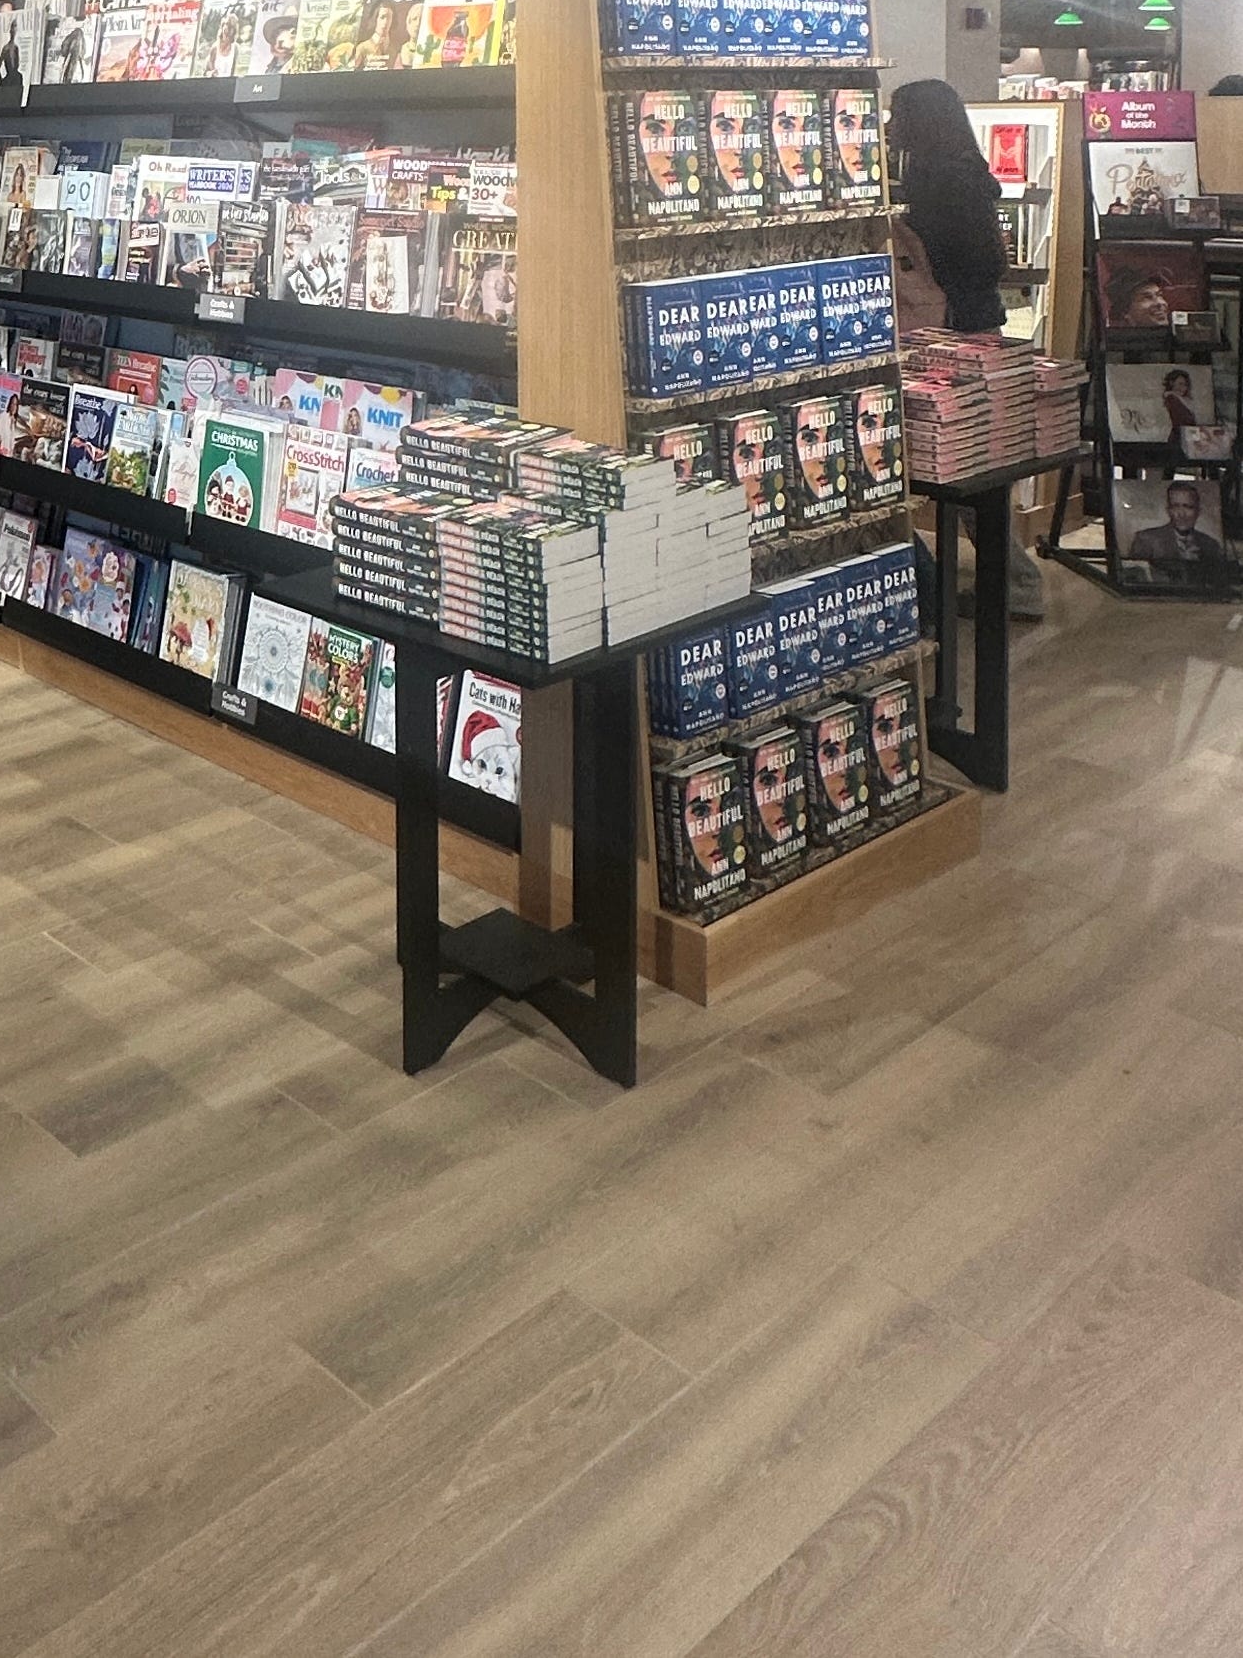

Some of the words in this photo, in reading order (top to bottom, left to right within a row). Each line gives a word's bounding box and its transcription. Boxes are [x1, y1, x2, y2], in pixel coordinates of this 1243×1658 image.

[654, 105, 685, 120] HELLO
[724, 103, 752, 118] HELLO
[785, 102, 812, 117] HELLO
[846, 101, 870, 115] HELLO
[1121, 102, 1155, 112] Album
[1121, 119, 1156, 130] Month
[643, 134, 698, 153] BEAUTIFUL
[714, 133, 763, 150] BEAUTIFUL
[776, 131, 822, 147] BEAUTIFUL
[836, 129, 879, 144] BEAUTIFUL
[189, 168, 236, 182] WRITER'S
[392, 159, 430, 170] WOOD
[431, 186, 456, 200] Tips
[471, 188, 498, 200] 30+
[172, 209, 207, 224] ORION
[780, 286, 816, 304] DEAR
[822, 282, 859, 300] DEAR
[658, 306, 700, 326] DEAR
[706, 298, 749, 320] DEAR
[780, 308, 817, 325] EDWARD
[823, 302, 860, 318] EDWARD
[659, 329, 701, 346] EDWARD
[707, 322, 749, 339] EDWARD
[75, 394, 101, 410] Breathe
[868, 397, 893, 415] HELLO
[367, 407, 404, 428] KNIT
[809, 411, 836, 430] HELLO
[211, 430, 259, 451] CHRISTMAS
[745, 425, 773, 445] HELLO
[859, 425, 902, 446] BEAUTIFUL
[405, 435, 429, 447] HELLO
[431, 440, 473, 459] BEAUTIFUL
[674, 441, 702, 461] HELLO
[799, 439, 845, 462] BEAUTIFUL
[356, 463, 396, 482] Crochet
[401, 454, 426, 467] HELLO
[427, 459, 469, 478] BEAUTIFUL
[737, 455, 784, 479] BEAUTIFUL
[405, 472, 429, 485] HELLO
[430, 478, 472, 496] BEAUTIFUL
[335, 506, 358, 519] HELLO
[359, 513, 400, 533] BEAUTIFUL
[338, 525, 360, 539] HELLO
[362, 532, 404, 552] BEAUTIFUL
[338, 544, 361, 559] HELLO
[363, 551, 405, 572] BEAUTIFUL
[339, 562, 363, 578] HELLO
[364, 570, 406, 591] BEAUTIFUL
[884, 567, 916, 589] DEAR
[338, 584, 362, 599] HELLO
[364, 591, 406, 612] BEAUTIFUL
[846, 580, 882, 603] DEAR
[885, 587, 918, 607] EDWARD
[779, 606, 816, 632] DEAR
[847, 600, 884, 621] EDWARD
[329, 635, 360, 652] MYSTERY
[736, 622, 773, 648] DEAR
[780, 629, 818, 651] EDWARD
[327, 645, 359, 663] COLORS
[680, 639, 722, 666] DEAR
[736, 645, 776, 668] EDWARD
[680, 663, 724, 686] EDWARD
[469, 682, 488, 703] Cats
[489, 693, 507, 709] with
[884, 697, 908, 720] HELLO
[829, 722, 855, 743] HELLO
[876, 723, 918, 751] BEAUTIFUL
[767, 748, 796, 771] HELLO
[821, 747, 866, 777] BEAUTIFUL
[700, 776, 730, 802] HELLO
[757, 775, 805, 807] BEAUTIFUL
[688, 804, 744, 838] BEAUTIFUL
